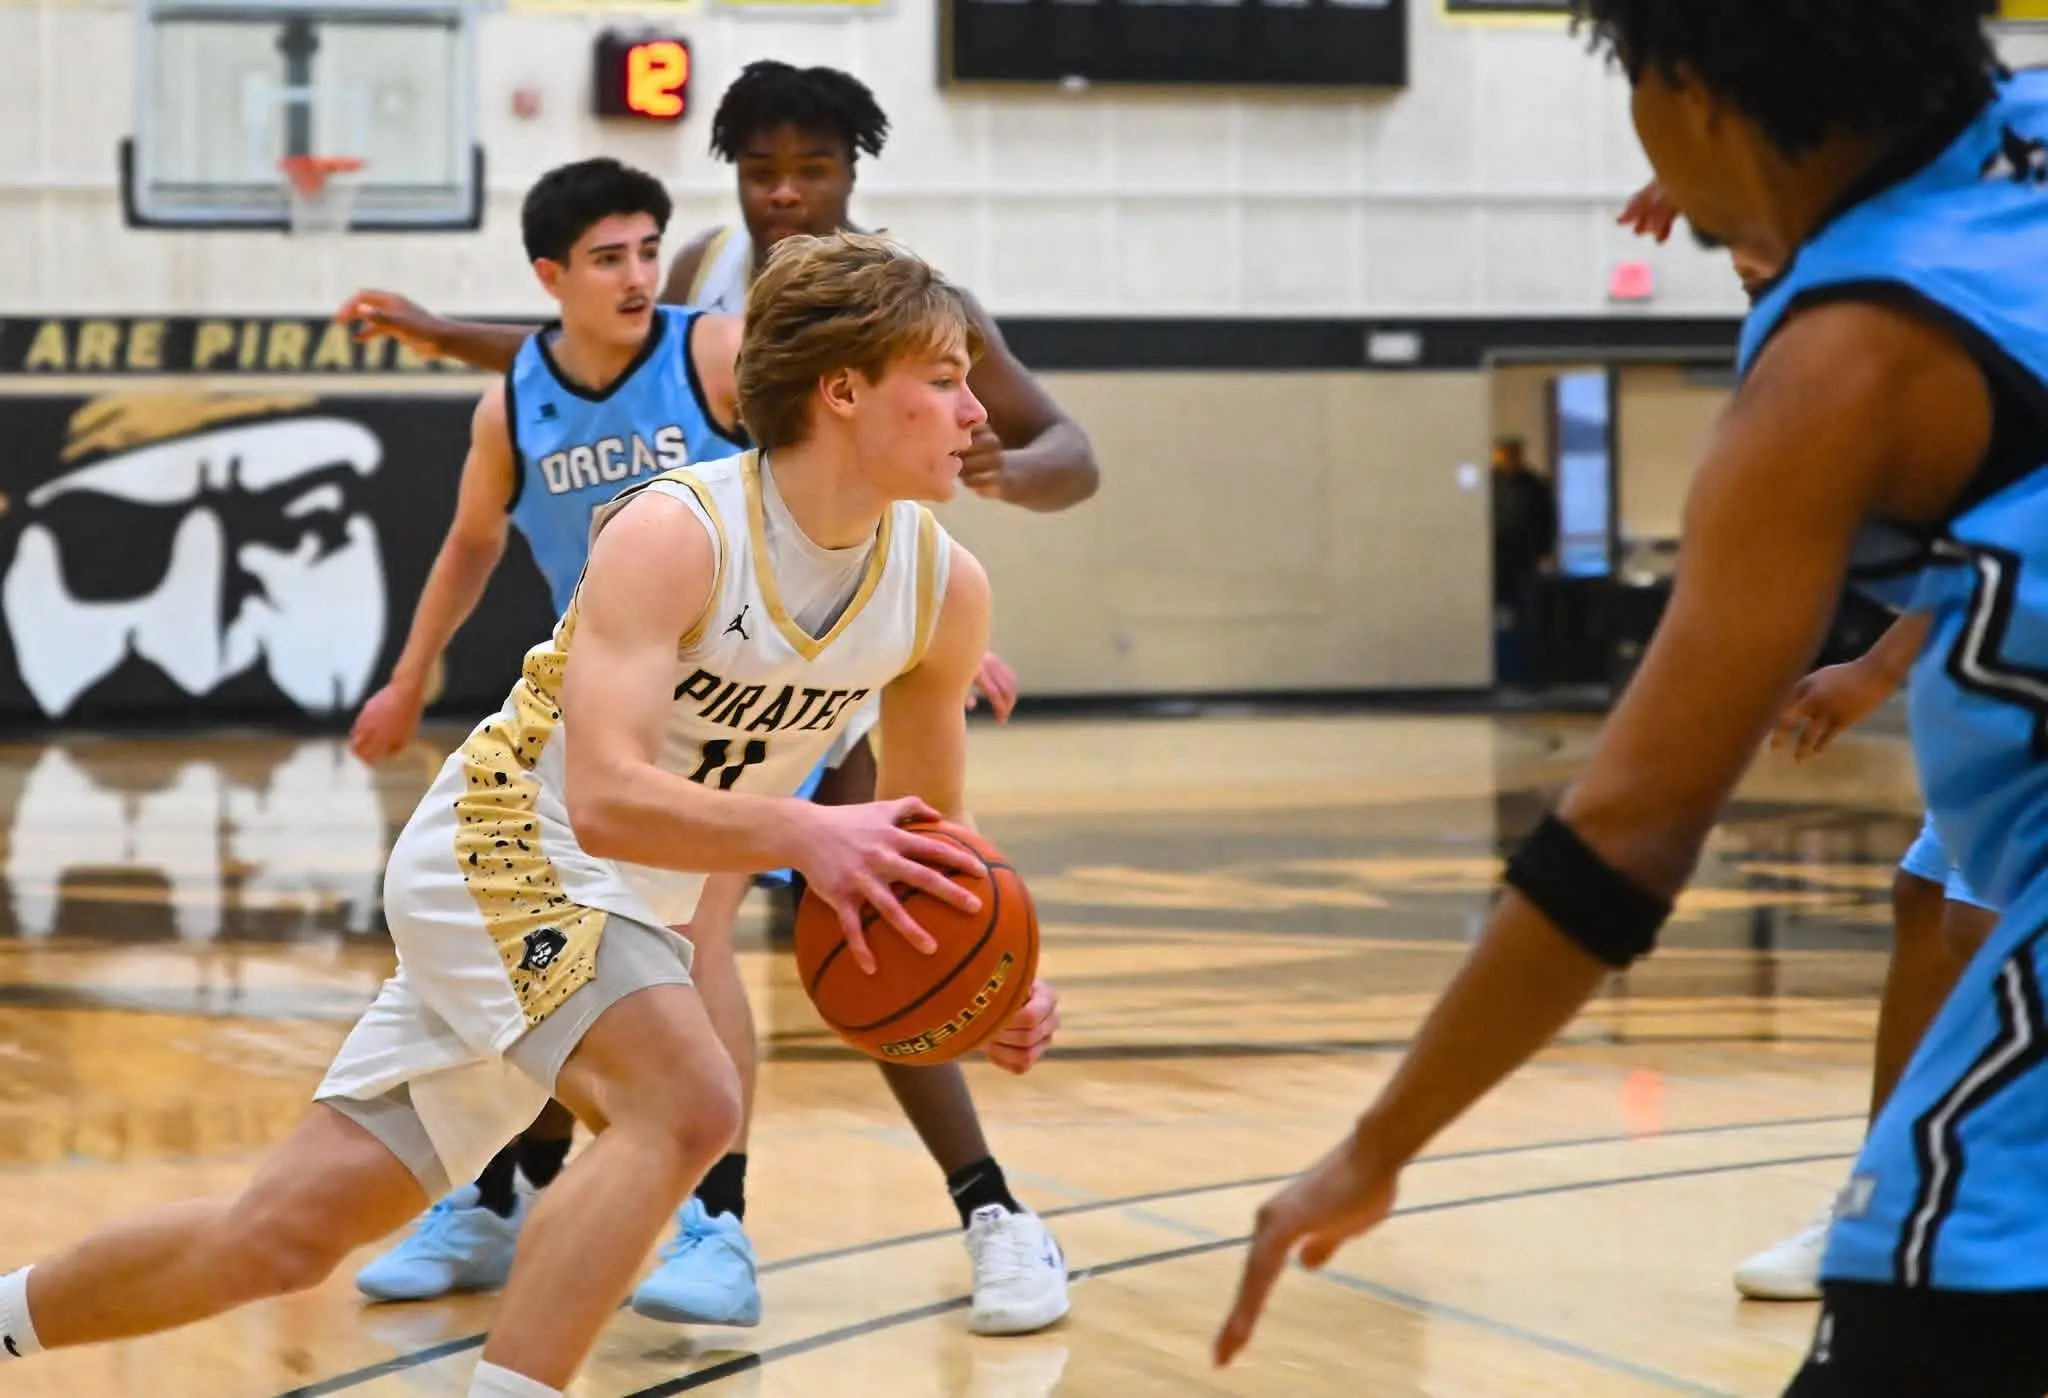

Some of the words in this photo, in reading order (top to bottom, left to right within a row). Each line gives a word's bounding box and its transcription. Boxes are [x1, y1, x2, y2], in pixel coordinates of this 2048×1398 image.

[627, 41, 689, 116] 12
[25, 321, 168, 369] ARE
[191, 321, 470, 370] PIRAT
[540, 425, 687, 494] ORCAS
[930, 951, 1015, 1044] ELITE
[878, 1031, 934, 1057] PRO
